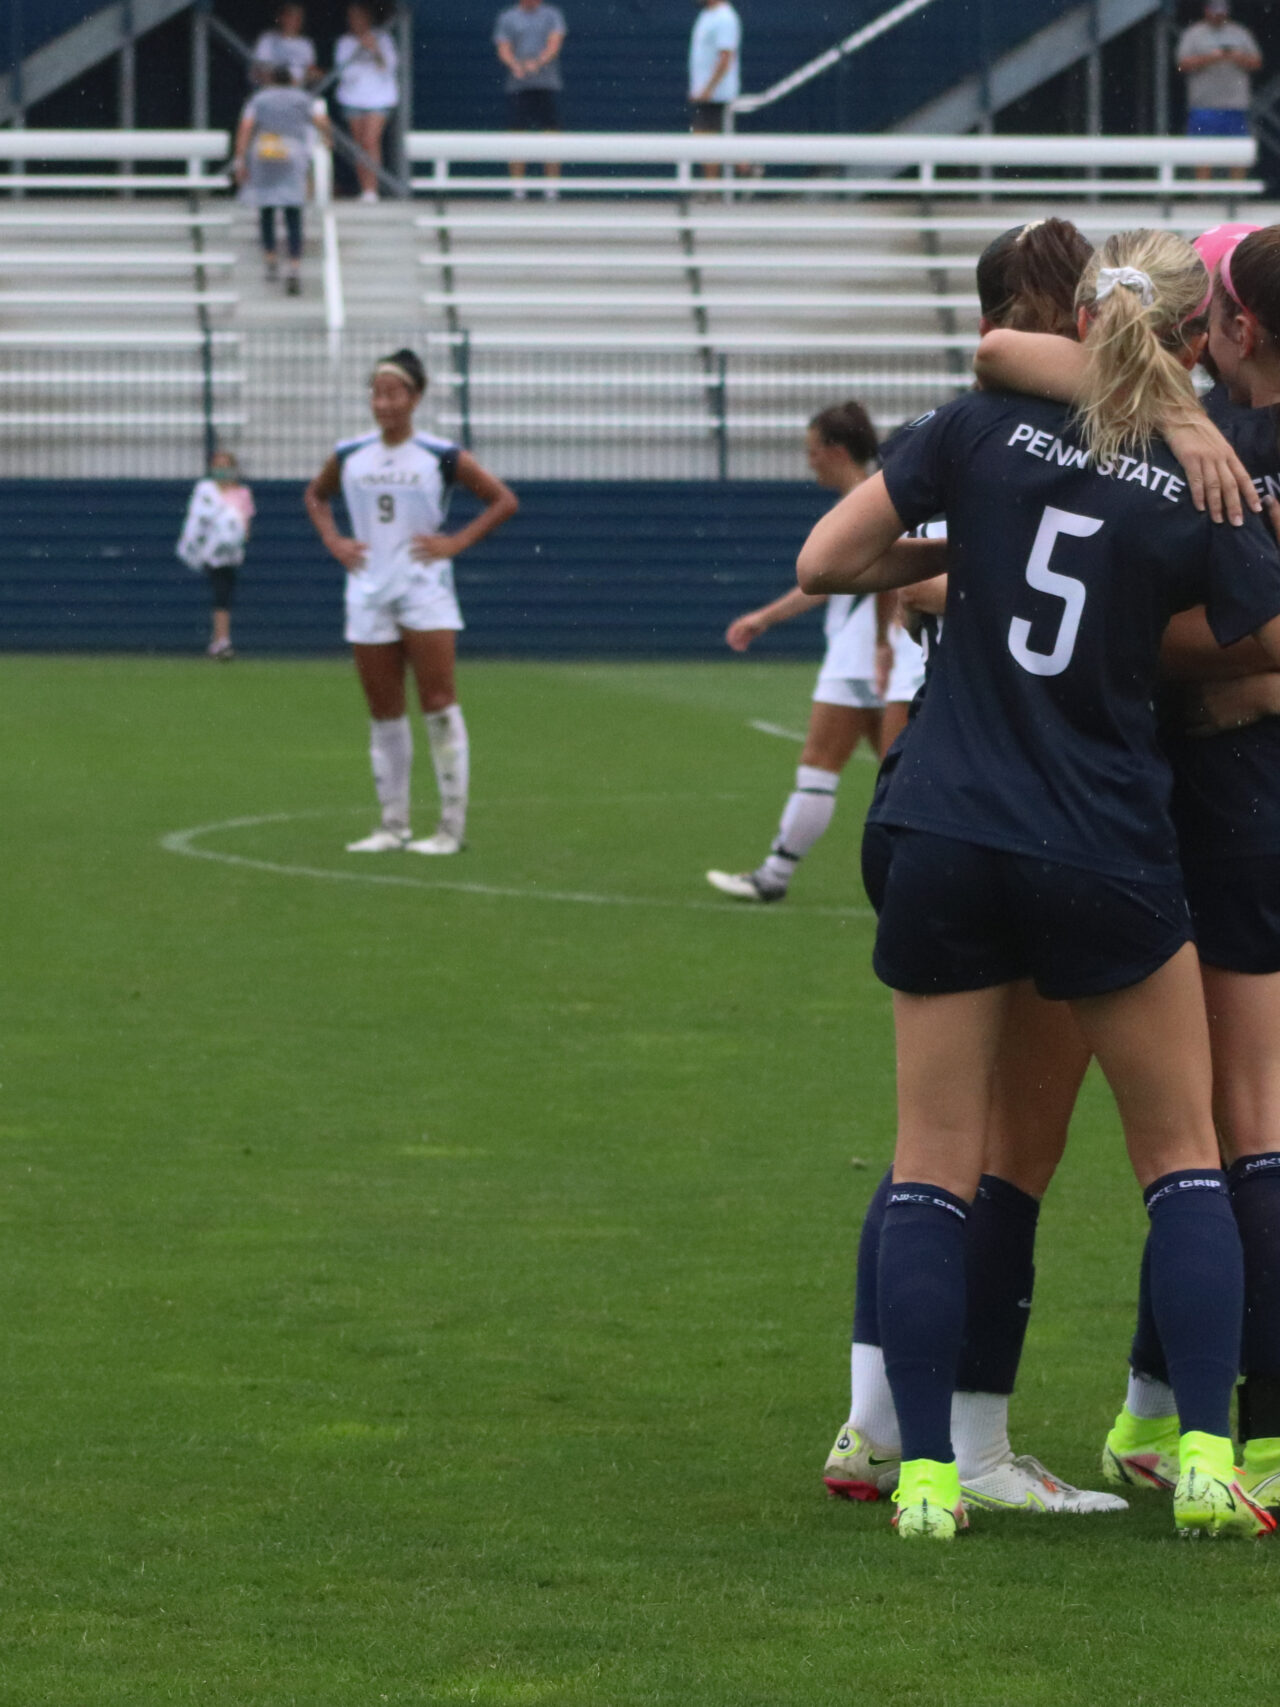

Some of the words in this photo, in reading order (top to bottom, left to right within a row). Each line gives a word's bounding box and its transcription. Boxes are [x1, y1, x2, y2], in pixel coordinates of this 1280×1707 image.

[1007, 423, 1092, 470] PENN
[1096, 453, 1186, 503] STATE
[377, 494, 395, 524] 9
[1008, 505, 1104, 676] 5
[1179, 1179, 1221, 1188] GRIP
